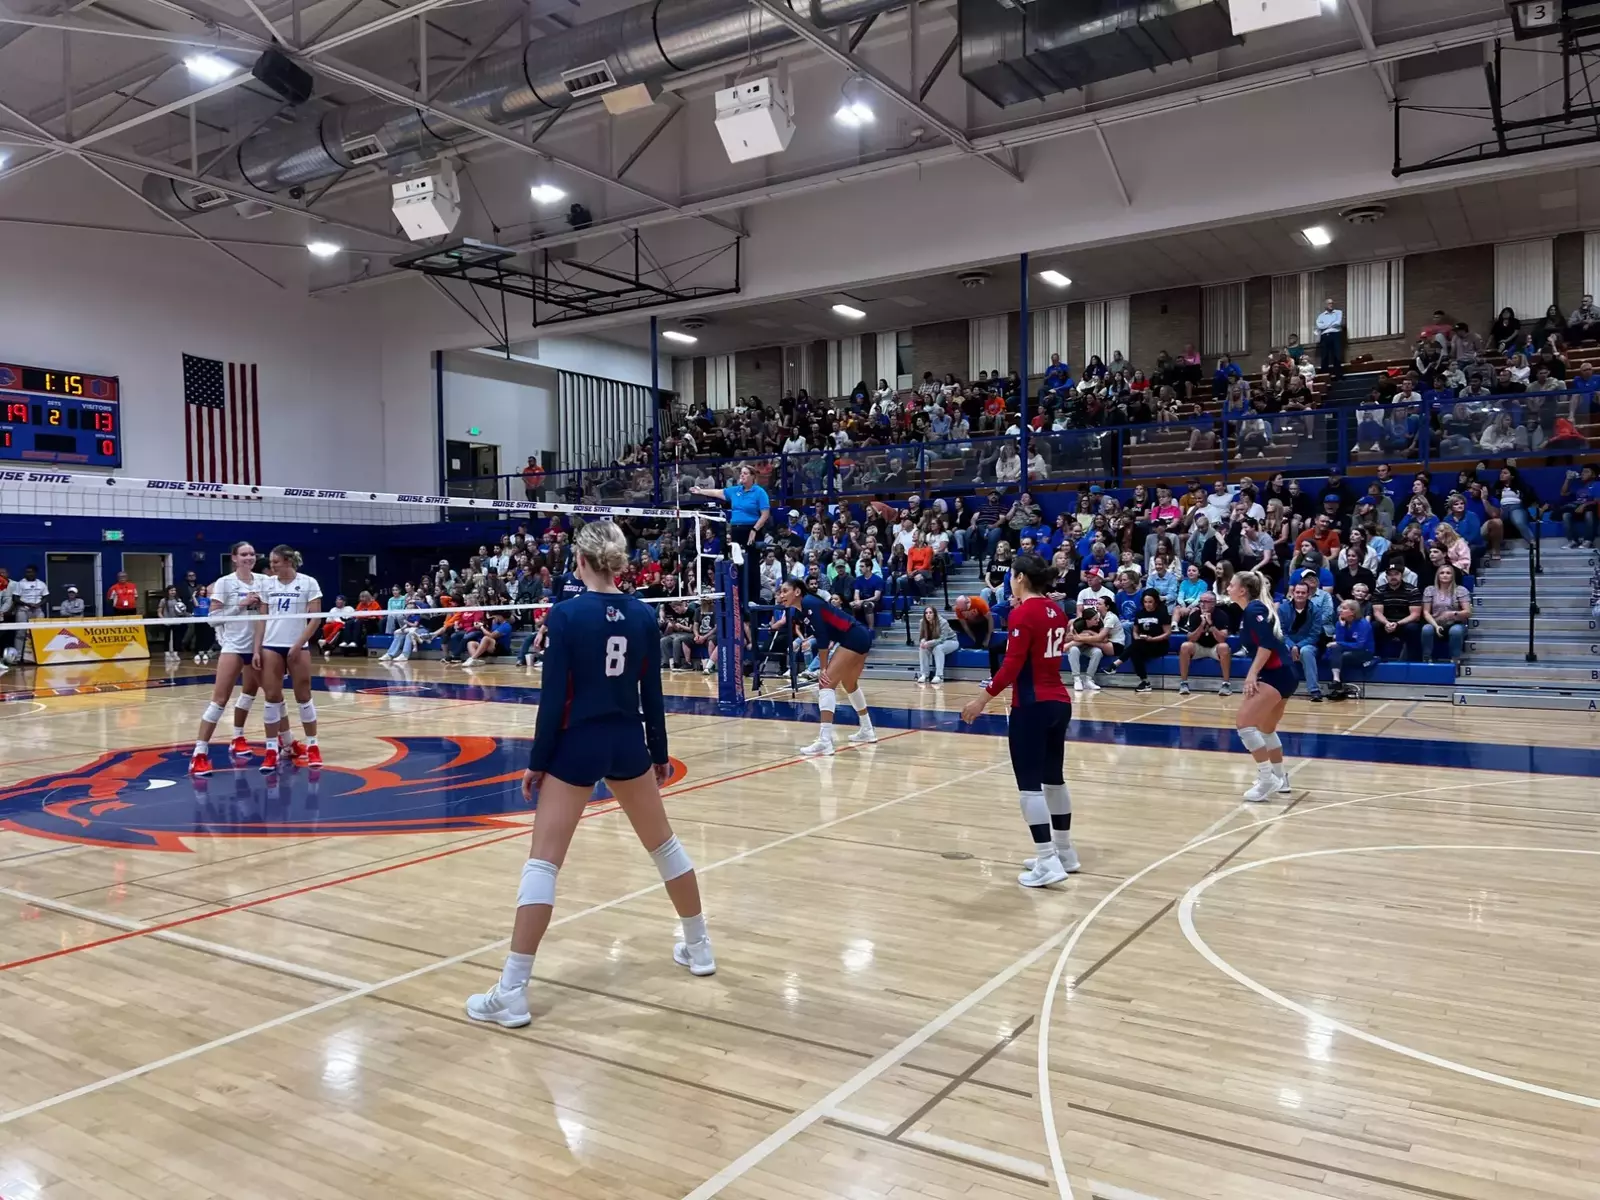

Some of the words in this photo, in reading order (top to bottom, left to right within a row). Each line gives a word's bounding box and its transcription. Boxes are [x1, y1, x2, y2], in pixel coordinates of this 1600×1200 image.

[1534, 5, 1545, 20] 3
[45, 373, 83, 395] 1:15
[82, 403, 112, 411] VISITORS
[7, 403, 28, 423] 19
[49, 409, 60, 425] 2
[95, 412, 113, 432] 13
[5, 432, 11, 447] 1
[102, 440, 114, 456] 0
[0, 471, 25, 481] ISE
[27, 473, 72, 484] STATE
[147, 480, 186, 490] BOISE
[188, 482, 223, 492] STATE
[284, 488, 316, 497] BOISE
[317, 490, 347, 499] STATE
[397, 494, 423, 503] BOISE
[425, 495, 450, 504] STATE
[492, 500, 515, 508] BOISE
[516, 501, 537, 509] STATE
[277, 598, 291, 612] 14
[1473, 619, 1479, 628] D
[1589, 620, 1596, 629] D
[83, 627, 139, 636] MOUNTAIN
[91, 634, 137, 644] AMERICA
[1044, 627, 1065, 658] 12
[1469, 642, 1476, 651] C
[1591, 645, 1598, 654] C
[605, 635, 628, 677] 8
[1465, 667, 1472, 676] B
[1591, 670, 1599, 680] B
[1459, 695, 1467, 705] A
[1588, 700, 1597, 710] A
